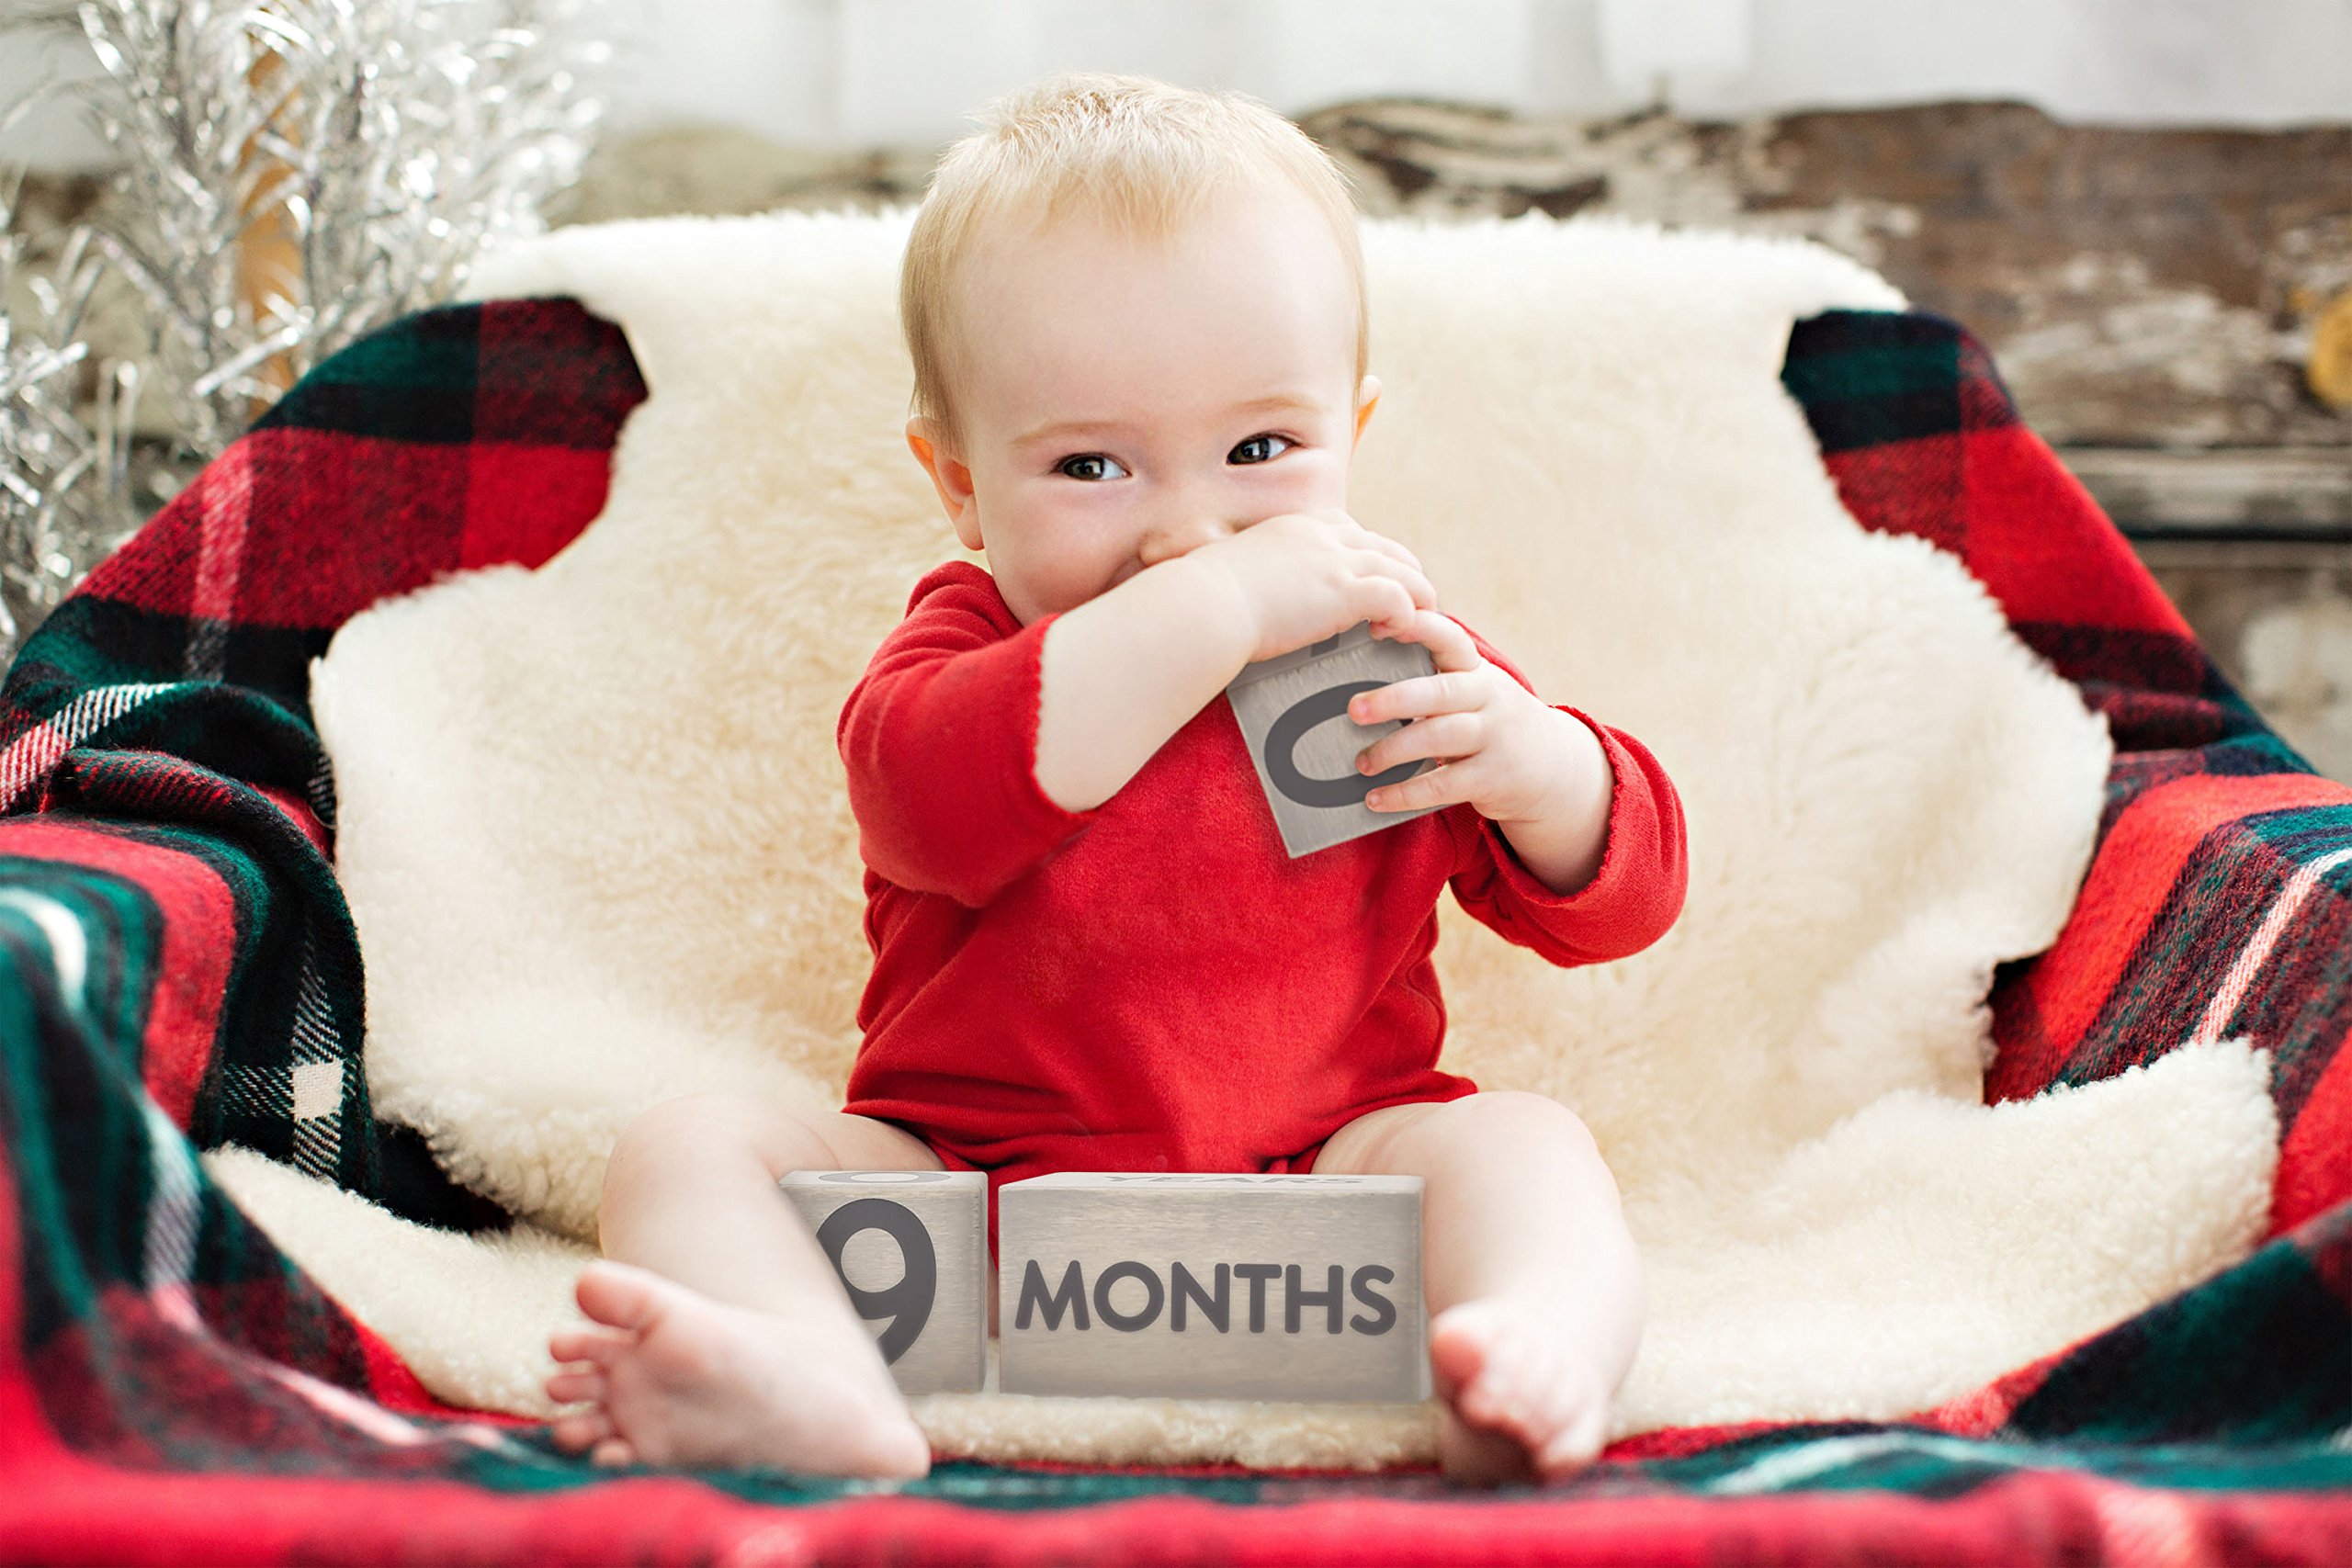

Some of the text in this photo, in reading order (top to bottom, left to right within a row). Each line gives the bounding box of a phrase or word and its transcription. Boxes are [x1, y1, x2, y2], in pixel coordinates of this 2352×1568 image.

[1104, 1176, 1367, 1184] YEARS
[816, 1198, 937, 1367] 9
[1014, 1259, 1396, 1336] MONTHS
